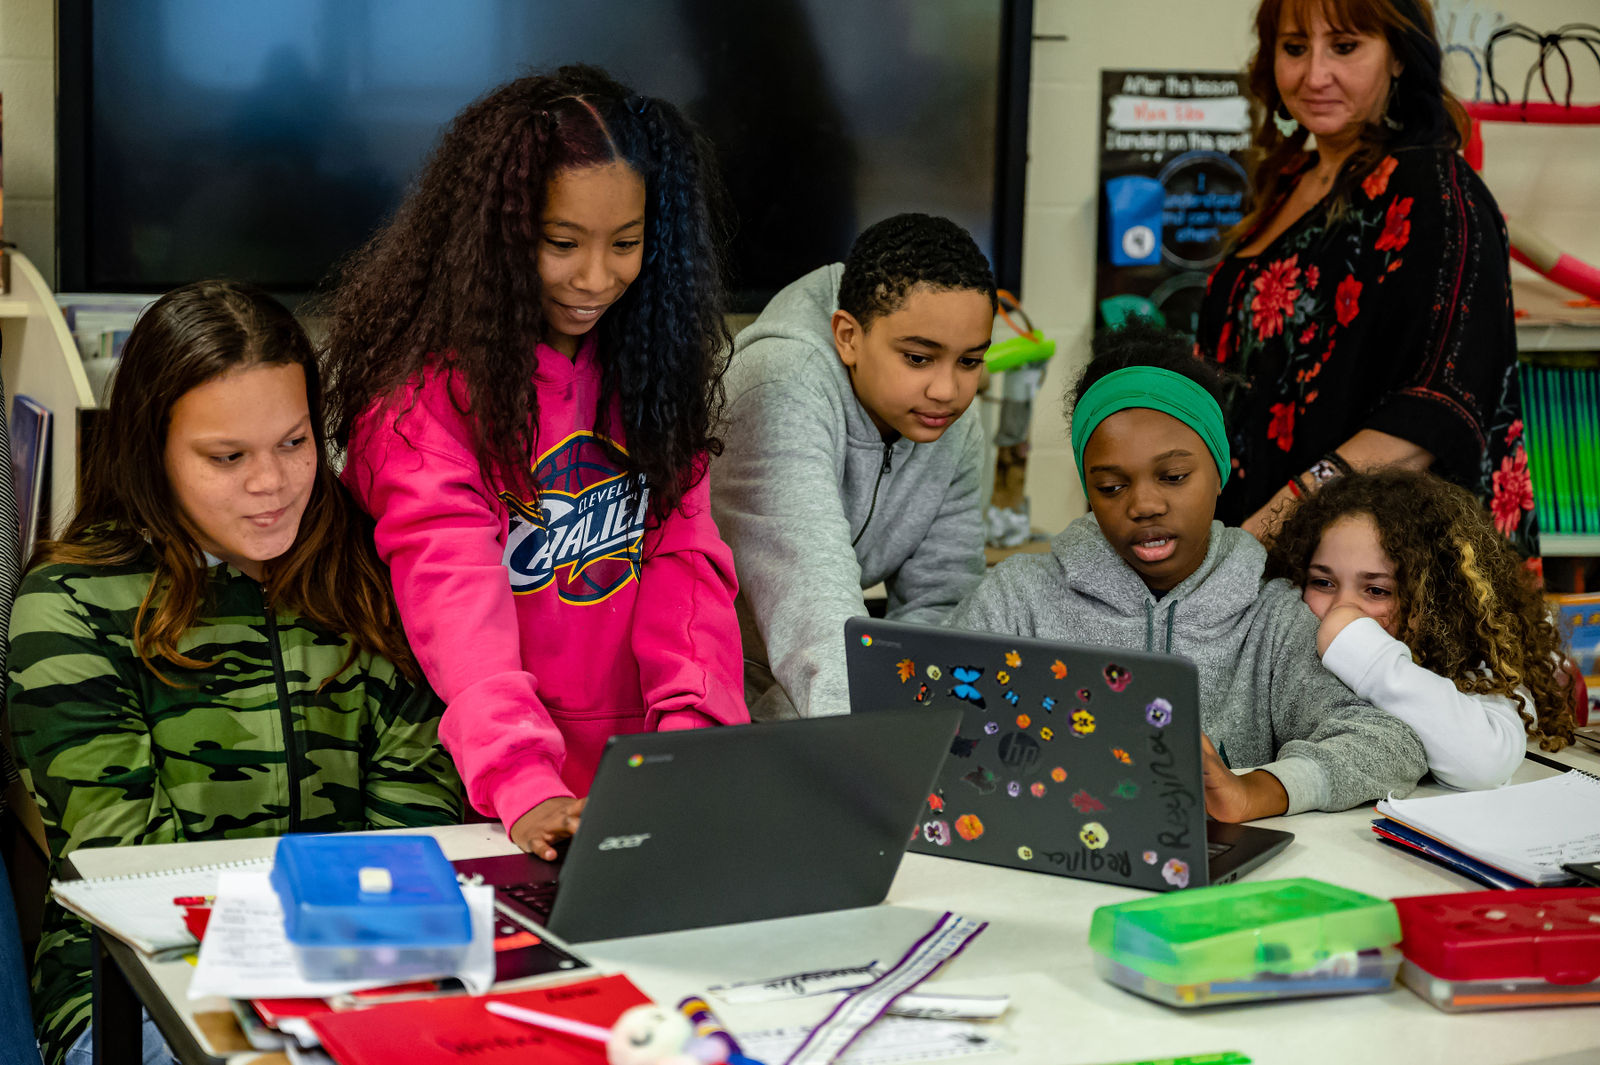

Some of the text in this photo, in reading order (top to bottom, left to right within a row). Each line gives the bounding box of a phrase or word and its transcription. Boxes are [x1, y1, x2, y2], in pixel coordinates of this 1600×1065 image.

[1122, 75, 1239, 96] After the lesson
[1167, 134, 1187, 150] on
[1187, 131, 1215, 150] this
[577, 472, 648, 515] CLEVELN
[598, 833, 652, 851] acer
